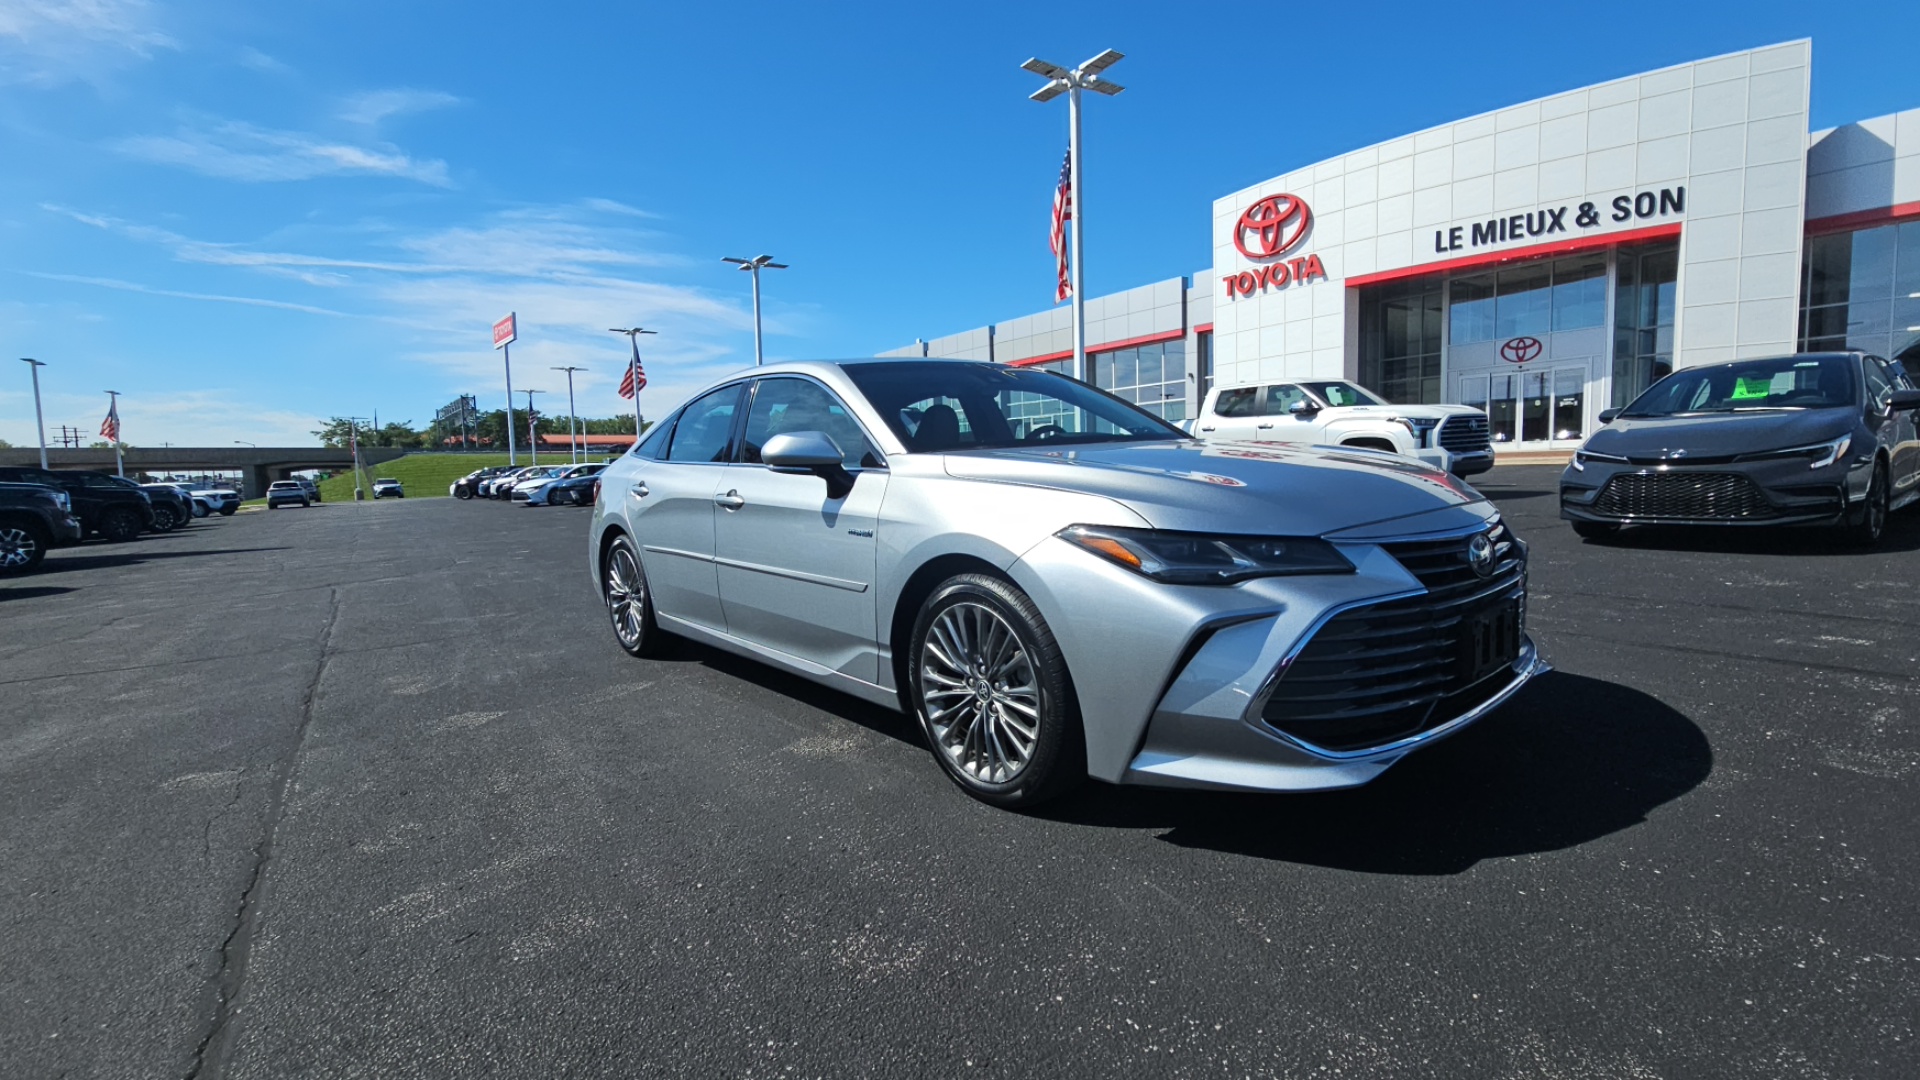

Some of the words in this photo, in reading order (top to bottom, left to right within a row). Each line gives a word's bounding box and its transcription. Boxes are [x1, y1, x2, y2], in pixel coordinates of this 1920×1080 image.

[1435, 226, 1463, 252] LE
[1472, 206, 1567, 246] MIEUX
[1575, 201, 1600, 228] &
[1612, 186, 1685, 222] SON
[1223, 254, 1326, 297] TOYOTA
